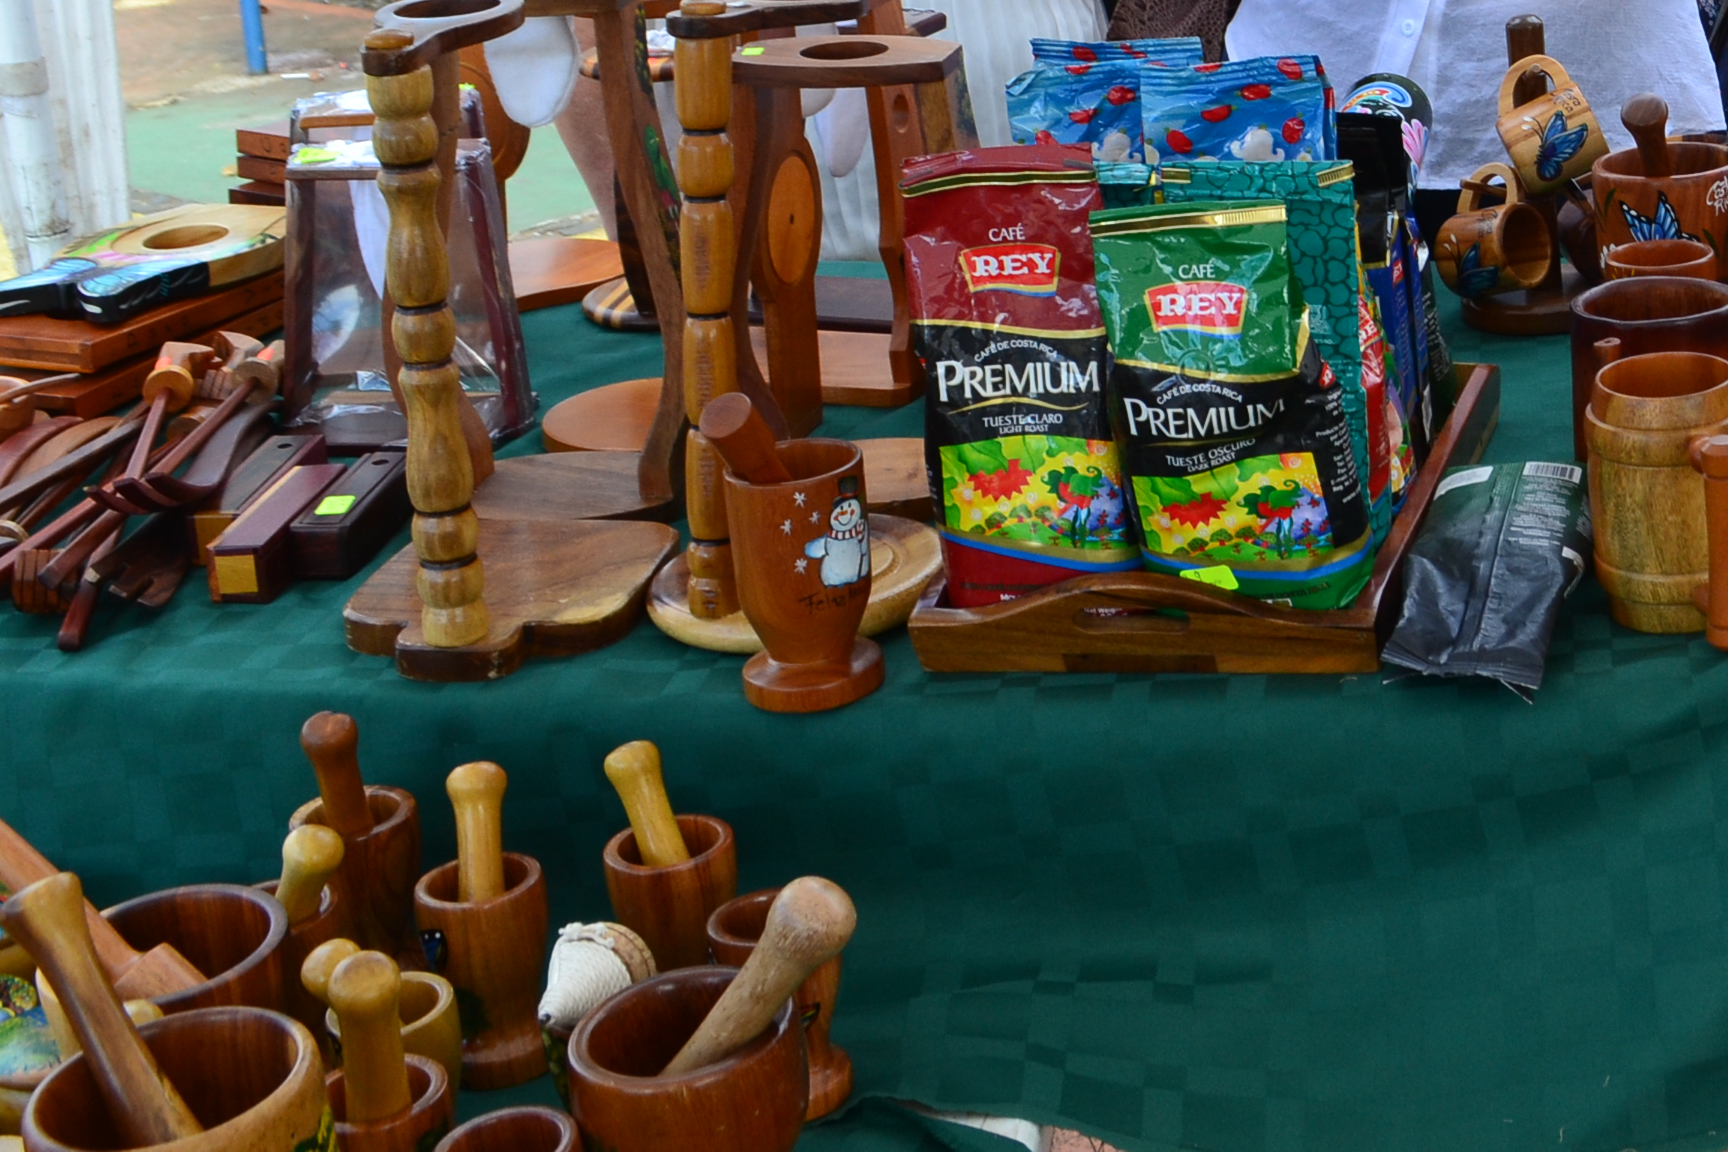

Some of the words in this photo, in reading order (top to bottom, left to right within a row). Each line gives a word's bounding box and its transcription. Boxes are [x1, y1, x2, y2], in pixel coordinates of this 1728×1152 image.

[988, 223, 1026, 242] CAFÉ
[971, 253, 1053, 278] REY
[1178, 260, 1215, 279] CAFÉ
[1156, 292, 1241, 317] REY
[974, 344, 998, 363] CAFÉ
[996, 341, 1009, 350] DE
[1010, 339, 1038, 349] COSTA
[936, 360, 1100, 402] PREMIUM
[1156, 387, 1180, 405] CAFÉ
[1180, 385, 1191, 395] DE
[1192, 383, 1222, 393] COSTA
[1221, 388, 1243, 403] RICA
[982, 416, 1025, 428] TUESTE
[1027, 413, 1063, 425] CLARO
[999, 425, 1023, 434] LIGHT
[1024, 424, 1049, 433] ROAST
[1123, 397, 1285, 439] PREMIUM
[1166, 453, 1206, 467] TUESTE
[1208, 437, 1256, 460] OSCURO
[1187, 462, 1210, 472] DARK
[1211, 452, 1236, 467] ROAST
